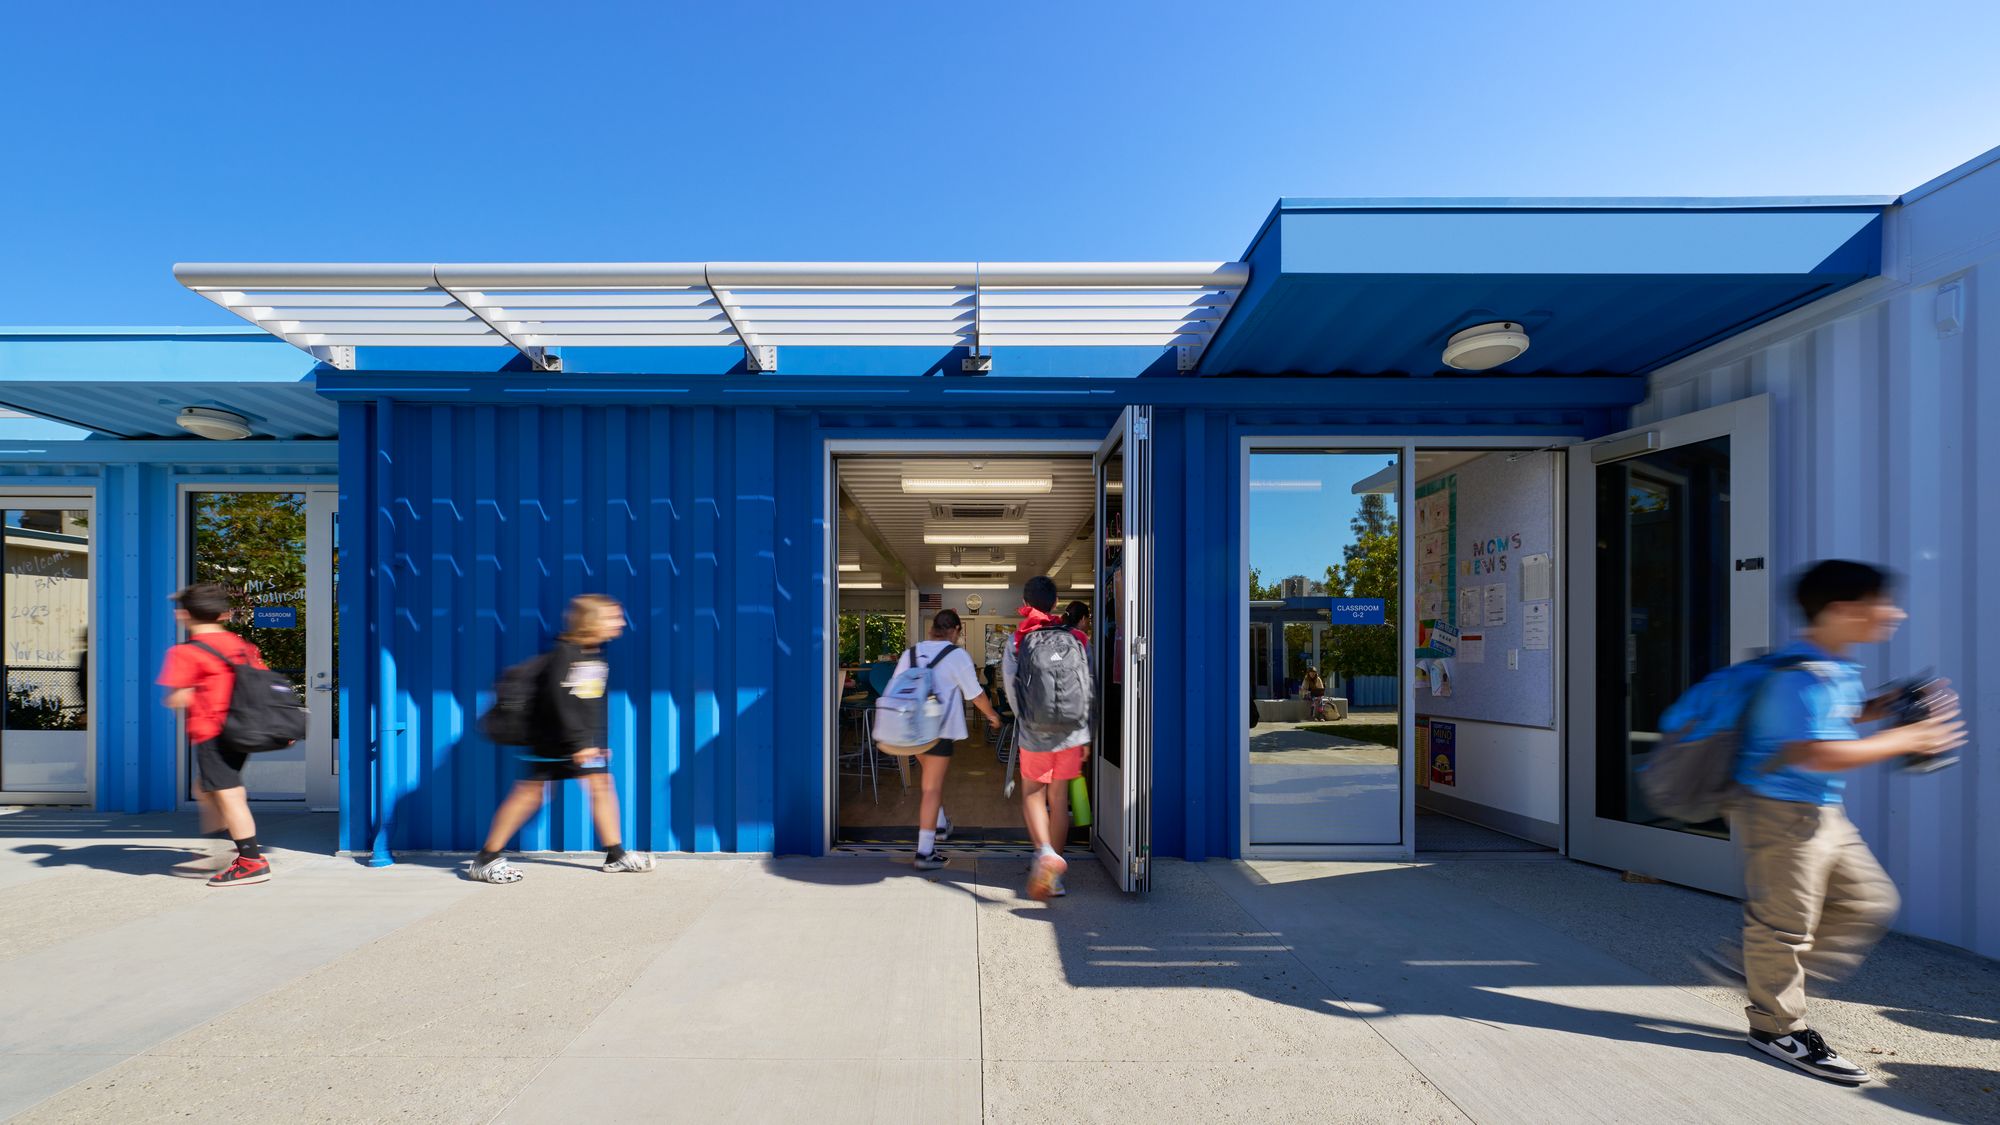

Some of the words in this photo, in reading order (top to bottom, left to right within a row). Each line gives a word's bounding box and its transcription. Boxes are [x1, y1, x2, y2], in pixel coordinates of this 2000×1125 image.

[1473, 533, 1522, 557] MCMS
[1461, 556, 1507, 576] NEWS
[11, 605, 50, 619] 2023
